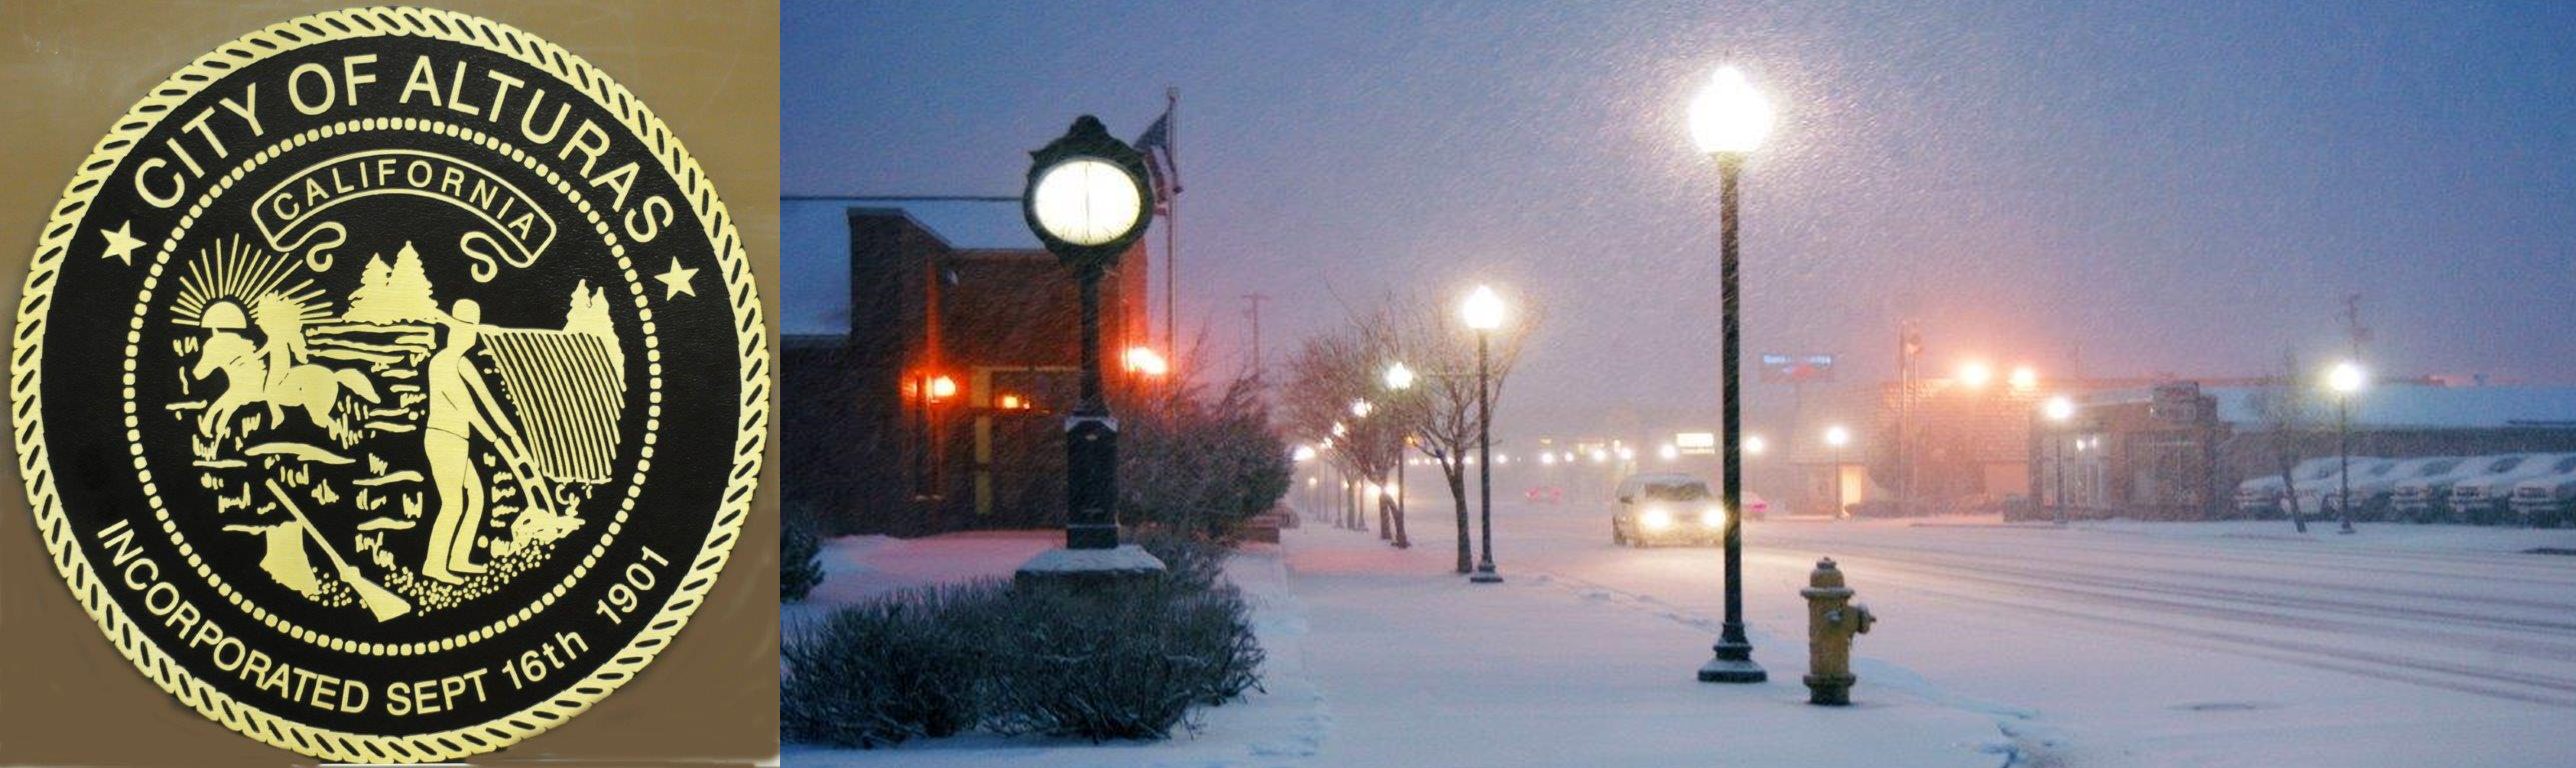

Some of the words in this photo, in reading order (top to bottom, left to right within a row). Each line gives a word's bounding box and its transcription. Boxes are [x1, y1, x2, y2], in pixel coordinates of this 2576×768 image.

[135, 82, 264, 208] CITY
[288, 54, 377, 115] OF
[399, 55, 674, 242] ALTURAS
[274, 159, 534, 240] CALIFORNIA
[98, 519, 369, 713] INCORPORATED
[387, 668, 487, 715] SEPT
[502, 632, 588, 689] 16th
[596, 546, 668, 624] 1901
